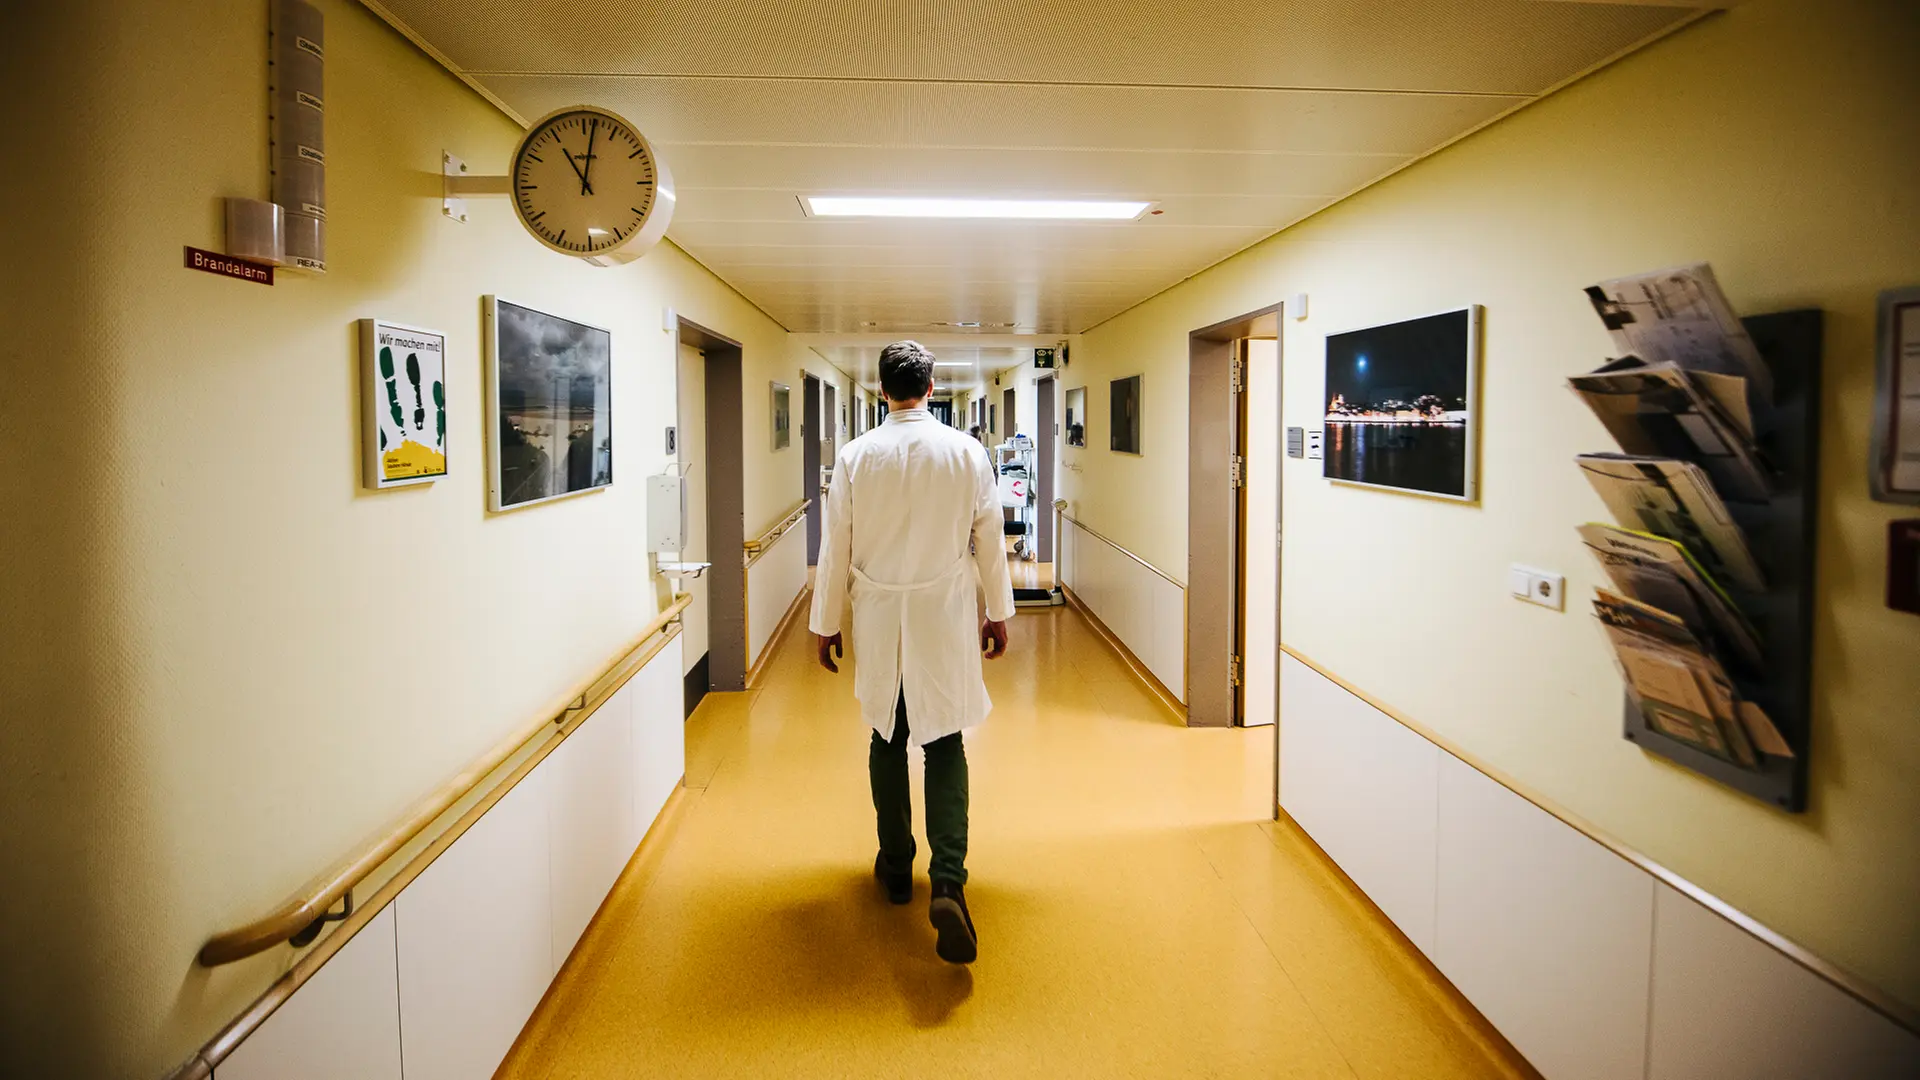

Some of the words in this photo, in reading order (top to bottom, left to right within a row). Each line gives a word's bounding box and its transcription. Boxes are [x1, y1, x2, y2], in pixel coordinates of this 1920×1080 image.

[194, 252, 267, 280] Brandalarm
[379, 333, 393, 346] Wir
[394, 337, 425, 350] machen
[426, 340, 441, 353] mit!
